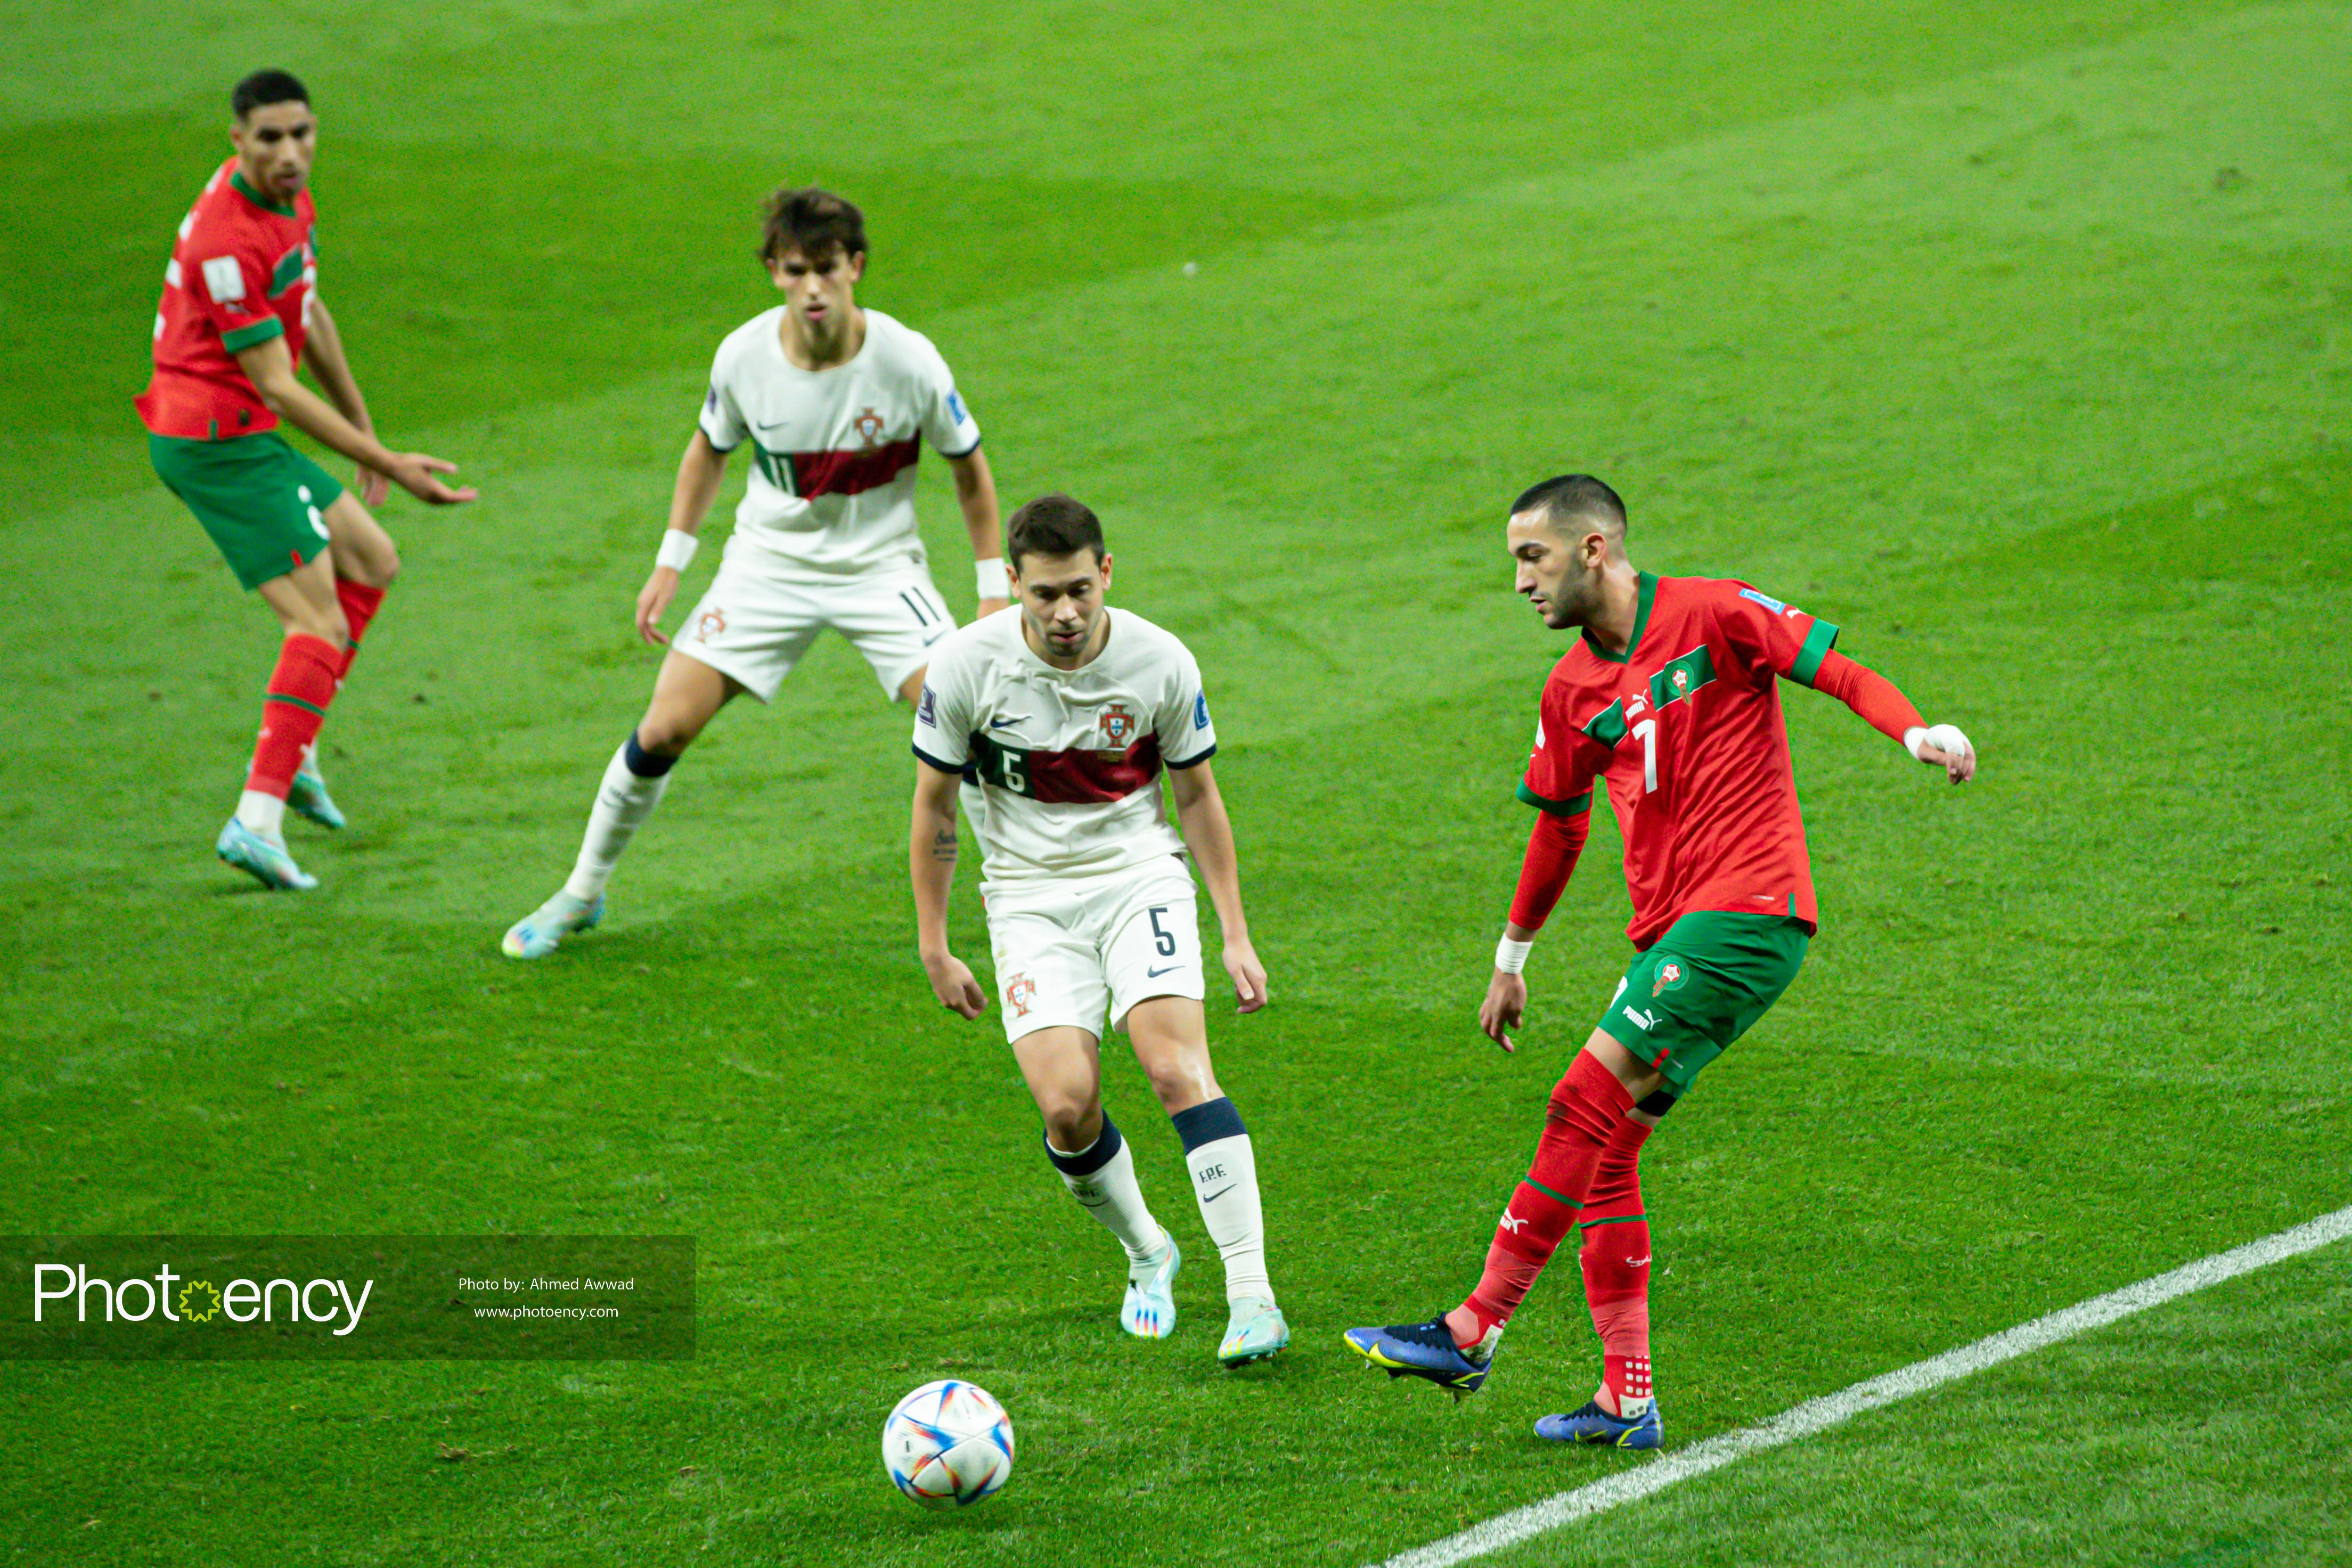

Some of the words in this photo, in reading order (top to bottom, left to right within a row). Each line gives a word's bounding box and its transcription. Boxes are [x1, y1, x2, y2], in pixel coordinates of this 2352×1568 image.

[767, 454, 795, 495] 11
[899, 586, 940, 626] 11
[1002, 750, 1025, 793] 5
[1148, 908, 1175, 956] 5
[1622, 1005, 1650, 1031] PUMA
